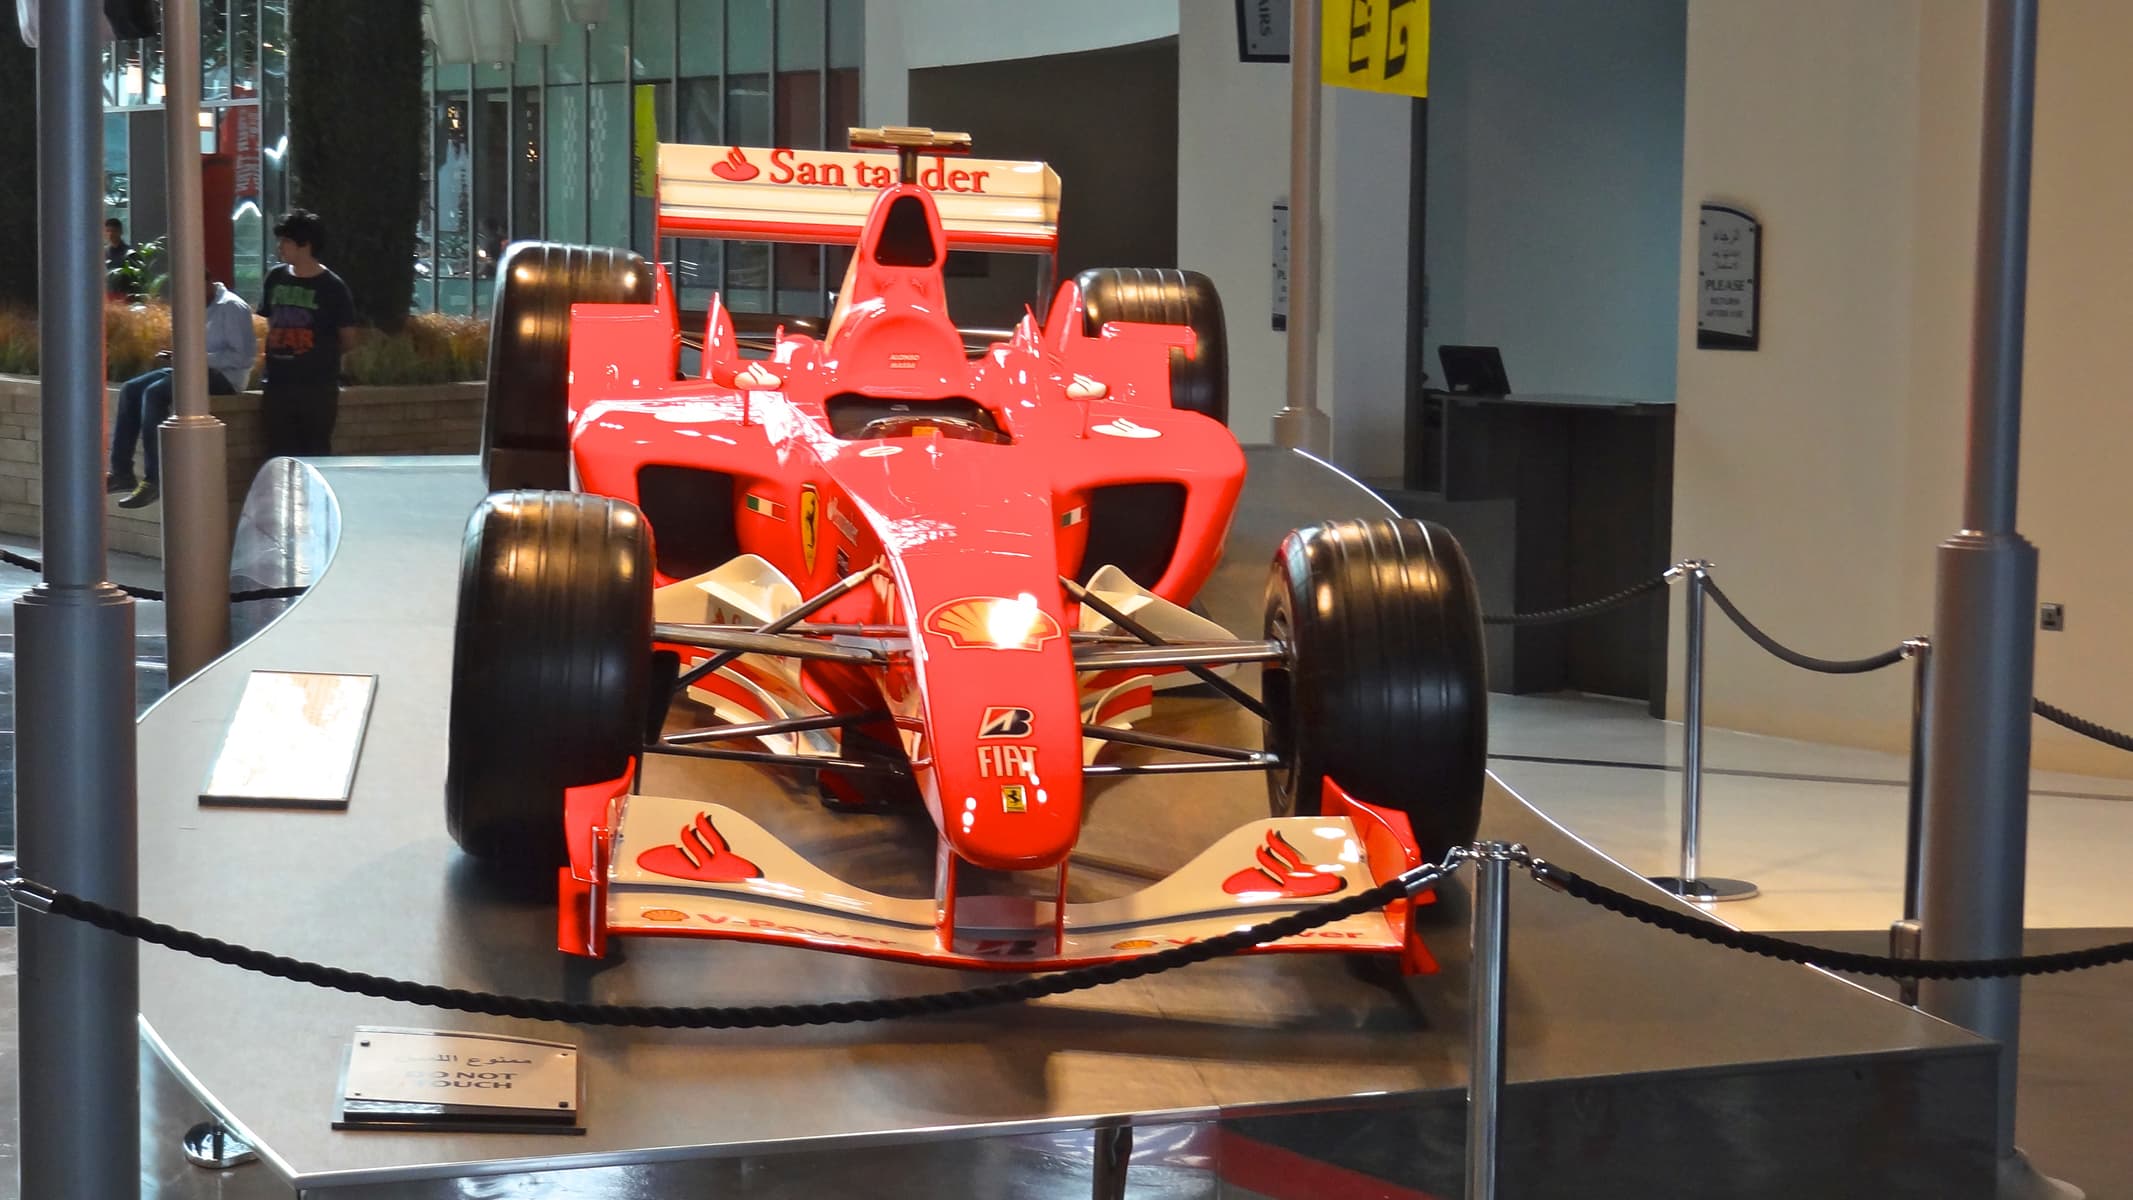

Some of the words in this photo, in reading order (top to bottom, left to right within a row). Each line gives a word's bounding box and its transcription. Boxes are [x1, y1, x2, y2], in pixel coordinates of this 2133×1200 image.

[769, 147, 989, 193] Santader
[977, 745, 1038, 778] FIAT
[457, 1072, 519, 1080] NOT
